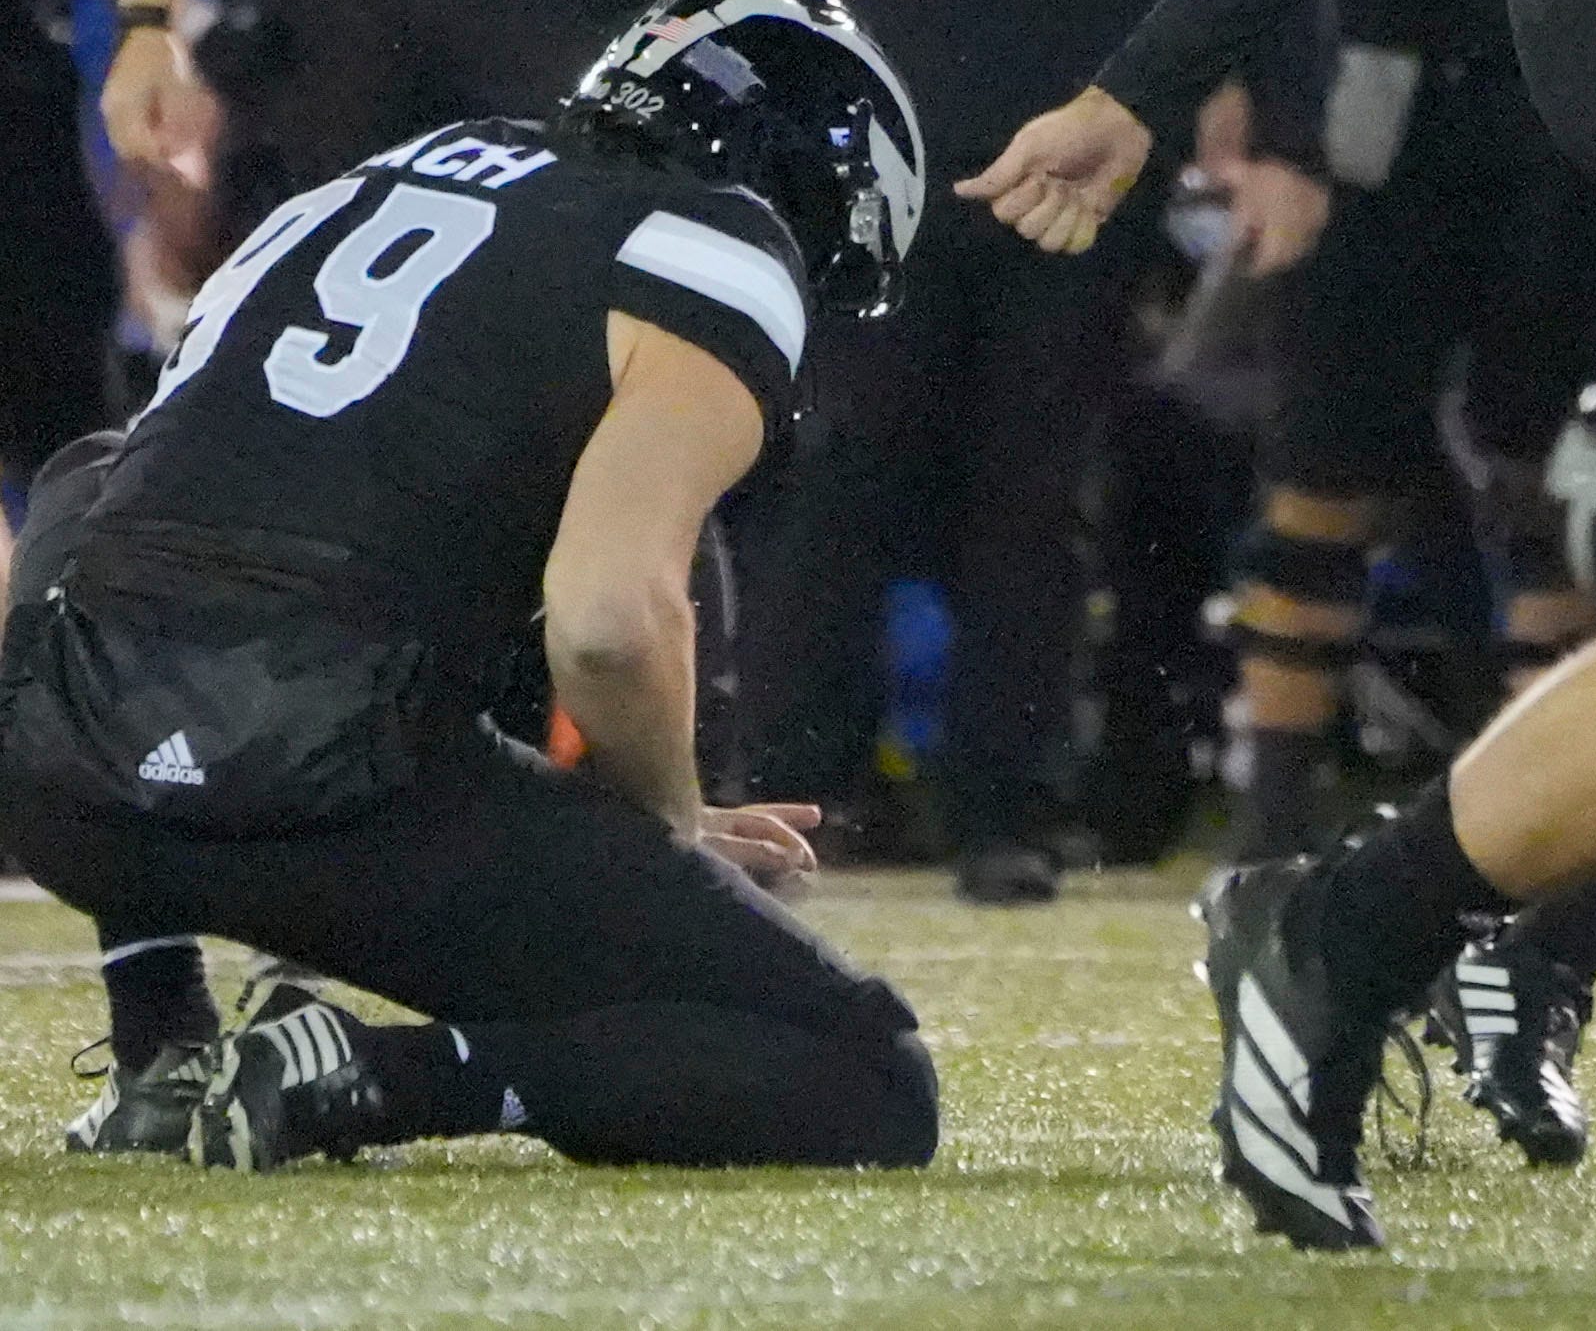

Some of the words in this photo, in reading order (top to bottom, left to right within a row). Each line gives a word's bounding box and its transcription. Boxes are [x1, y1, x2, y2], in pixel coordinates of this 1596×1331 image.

[610, 80, 665, 120] 302
[127, 163, 497, 418] 99
[138, 763, 205, 786] adidas
